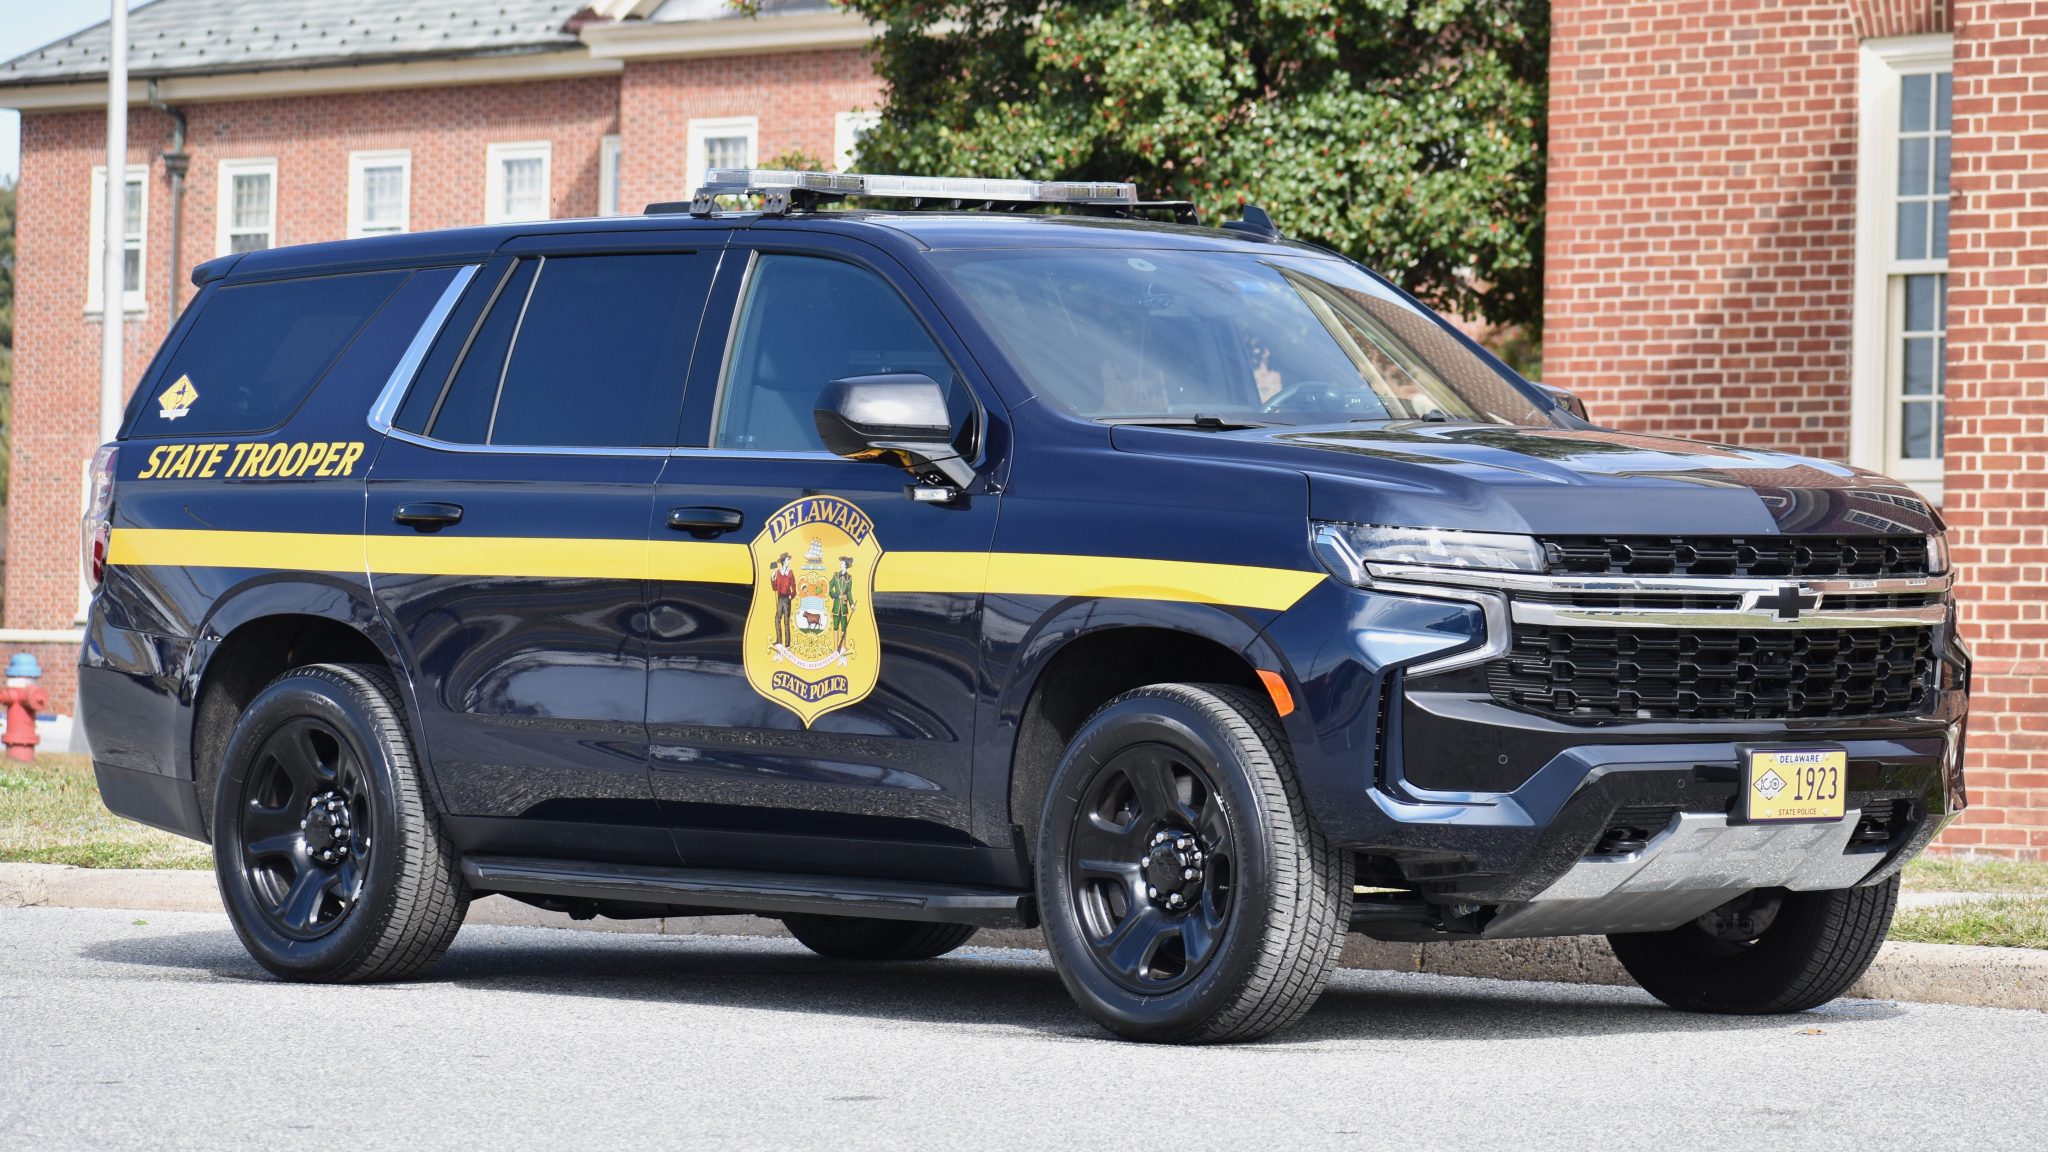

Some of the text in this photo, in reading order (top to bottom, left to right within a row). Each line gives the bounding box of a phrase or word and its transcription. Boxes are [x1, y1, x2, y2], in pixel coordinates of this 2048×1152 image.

[137, 441, 365, 479] STATE TROOPER
[770, 500, 870, 544] DELAWARE
[773, 673, 847, 700] STATE POLICE
[1779, 754, 1820, 764] DELAWARE
[1794, 766, 1838, 801] 1923
[1778, 807, 1817, 816] STATE POLICE
